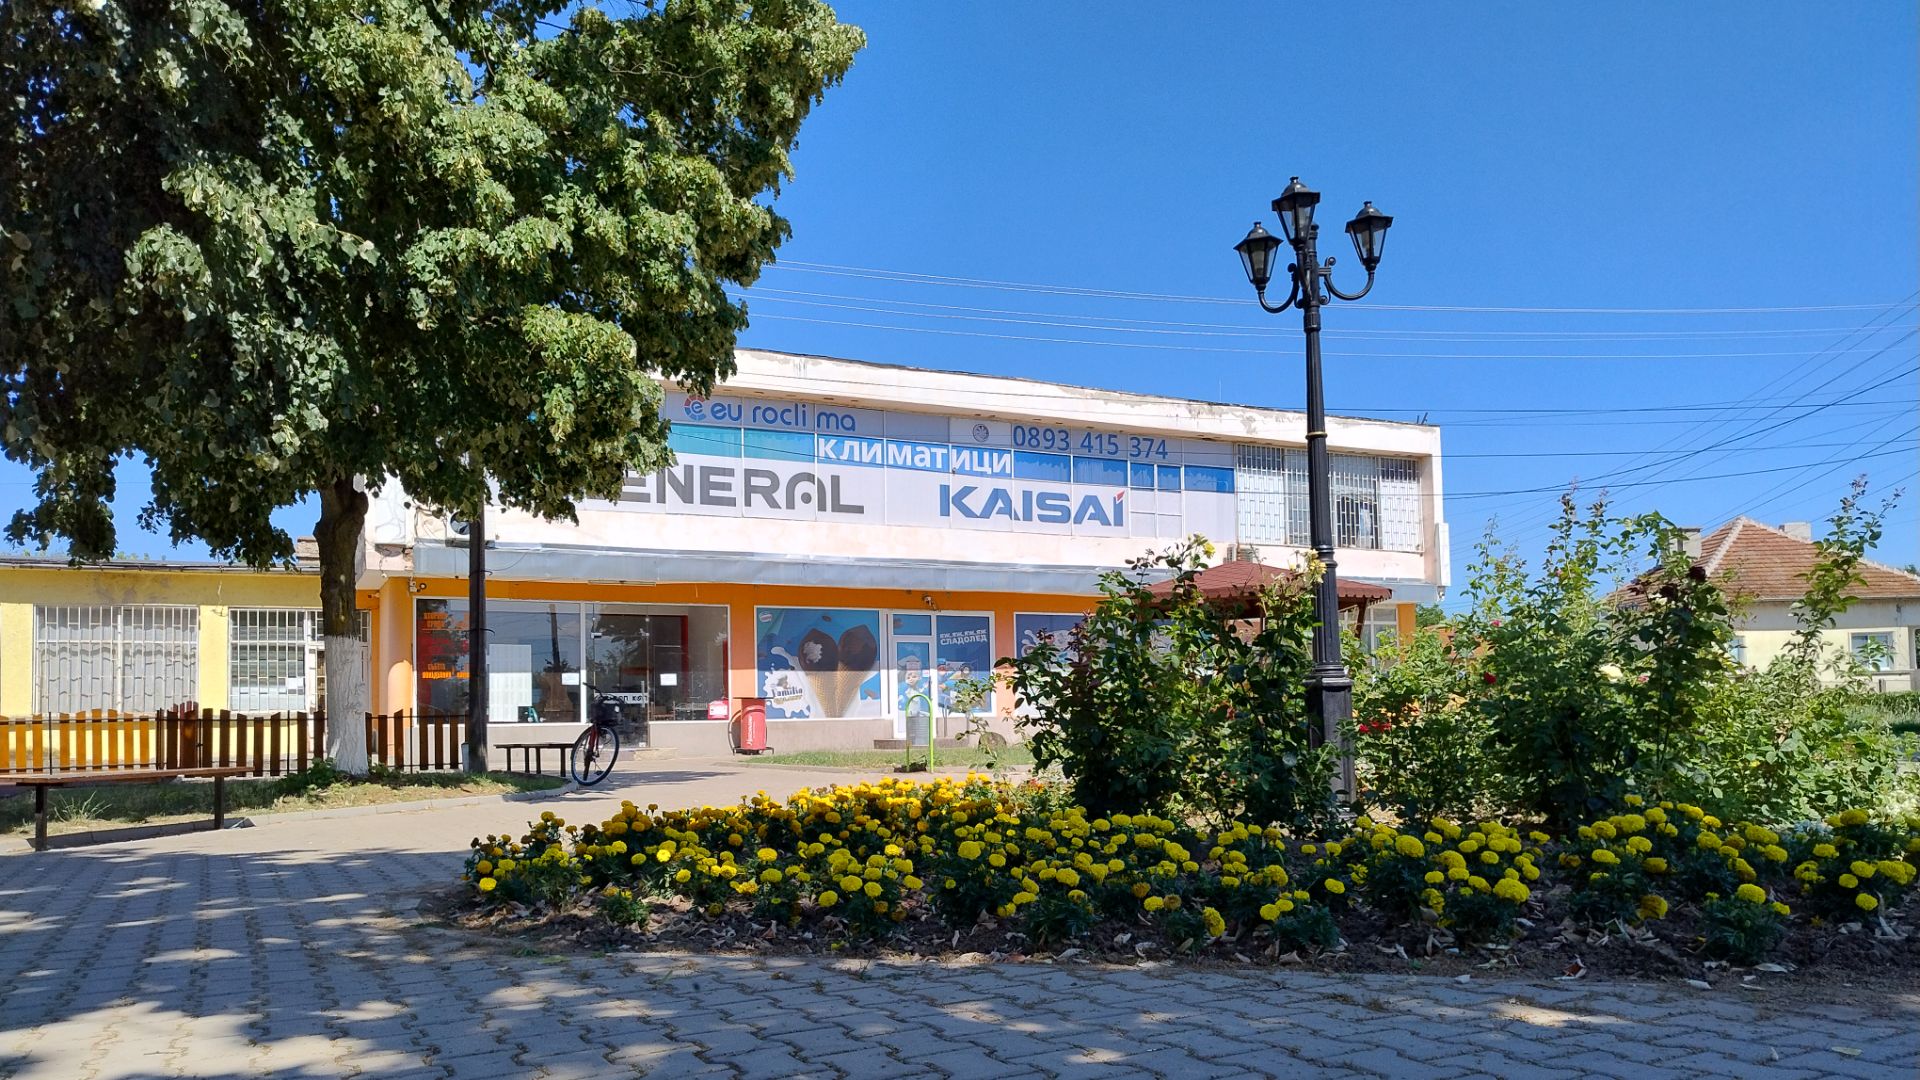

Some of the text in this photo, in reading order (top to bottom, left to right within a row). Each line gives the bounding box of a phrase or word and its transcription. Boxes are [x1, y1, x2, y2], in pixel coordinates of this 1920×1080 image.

[1013, 425, 1169, 460] 0893 415 374
[587, 462, 865, 515] ENERAL
[940, 484, 1126, 527] KAISAI
[940, 634, 988, 645] СЛАДОЛЕД
